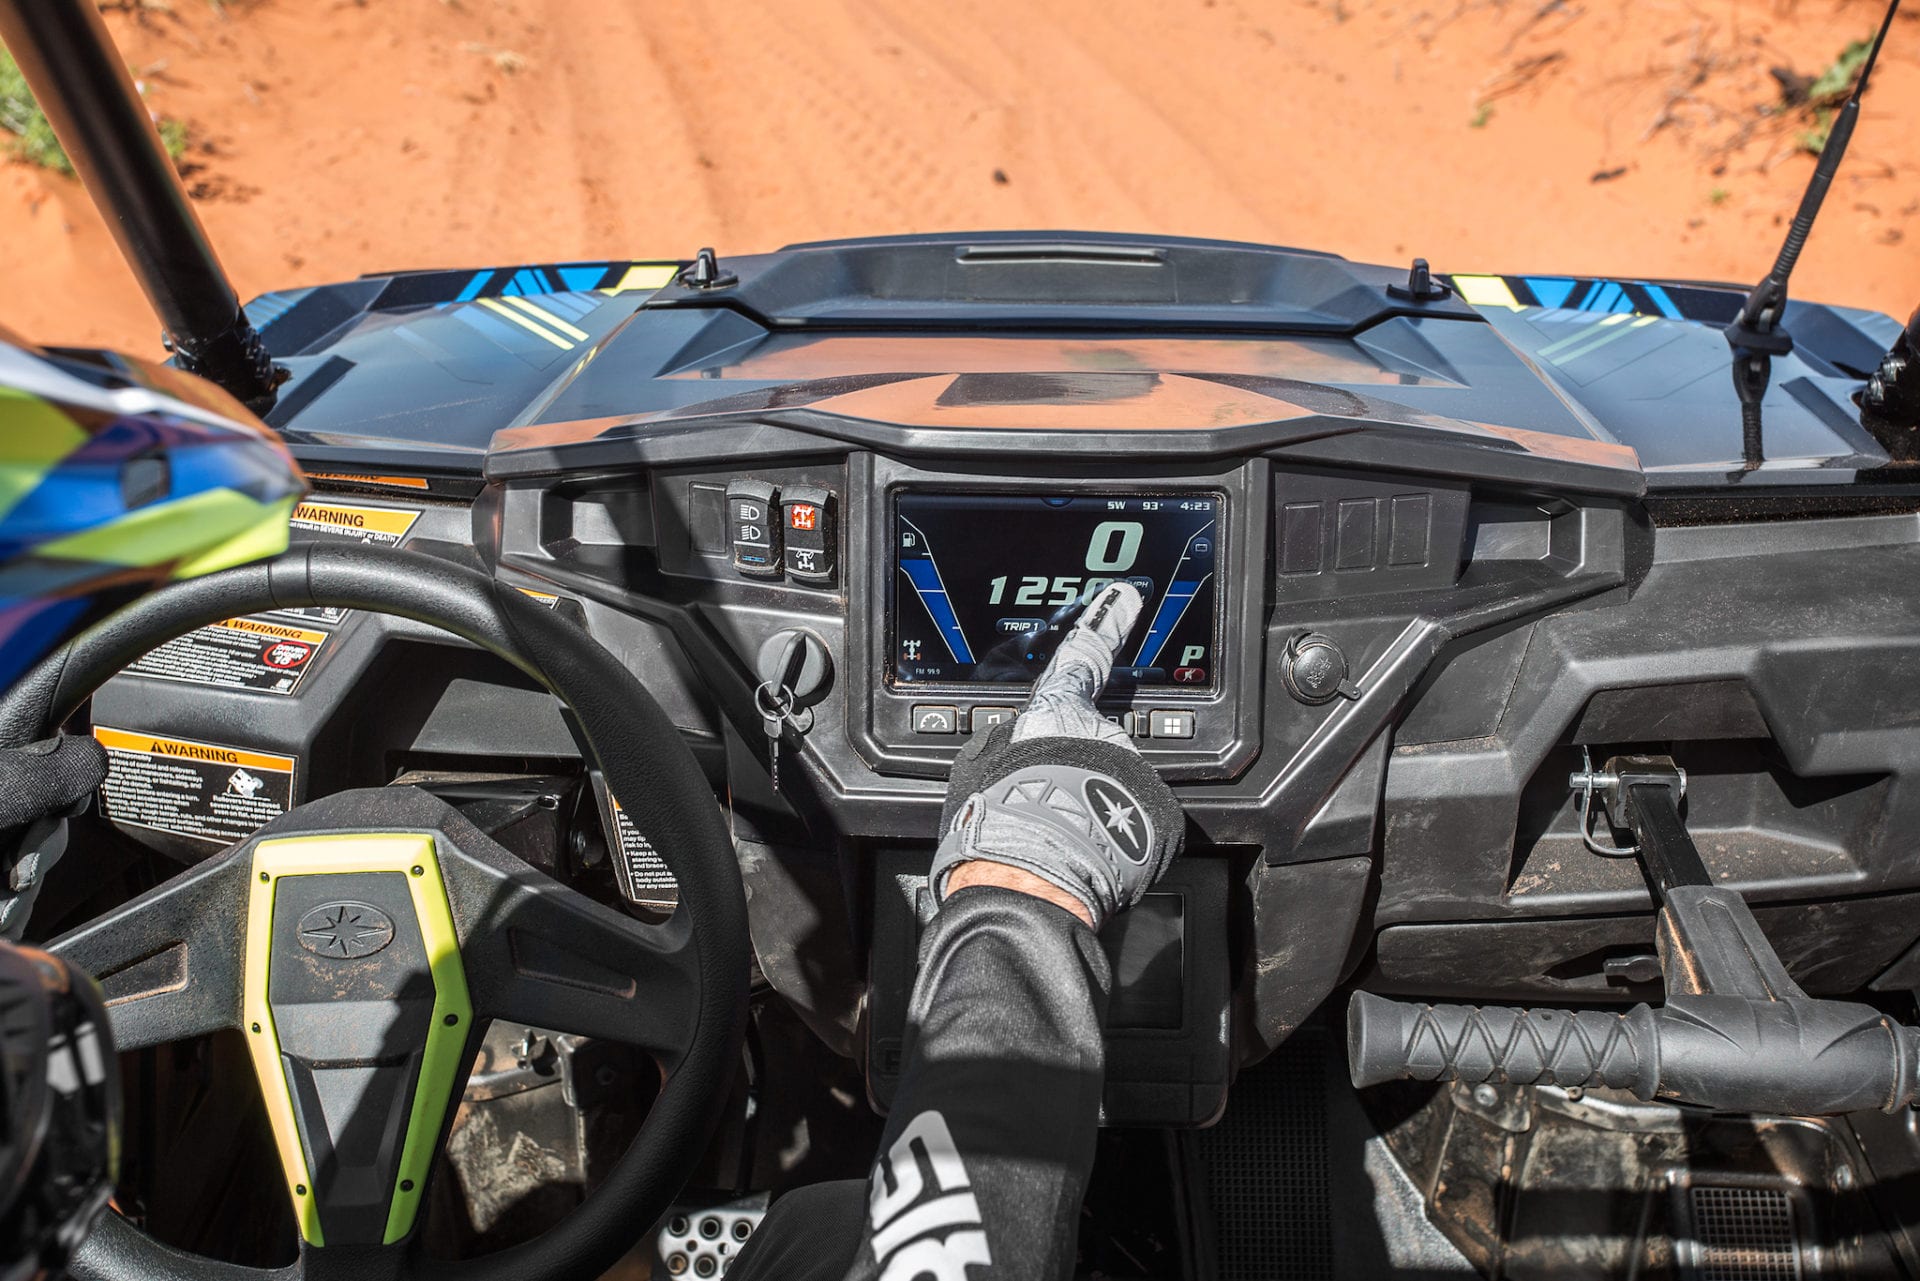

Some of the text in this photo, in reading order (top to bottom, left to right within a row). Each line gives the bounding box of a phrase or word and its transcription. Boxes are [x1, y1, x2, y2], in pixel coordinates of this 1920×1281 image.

[1107, 501, 1126, 510] SW
[1180, 501, 1210, 511] 4:23
[296, 506, 364, 527] WARNING
[1085, 521, 1144, 572] 0
[233, 620, 302, 639] WARNING
[1003, 622, 1039, 631] TRIP 1
[1180, 645, 1205, 667] P
[166, 743, 238, 763] WARNING
